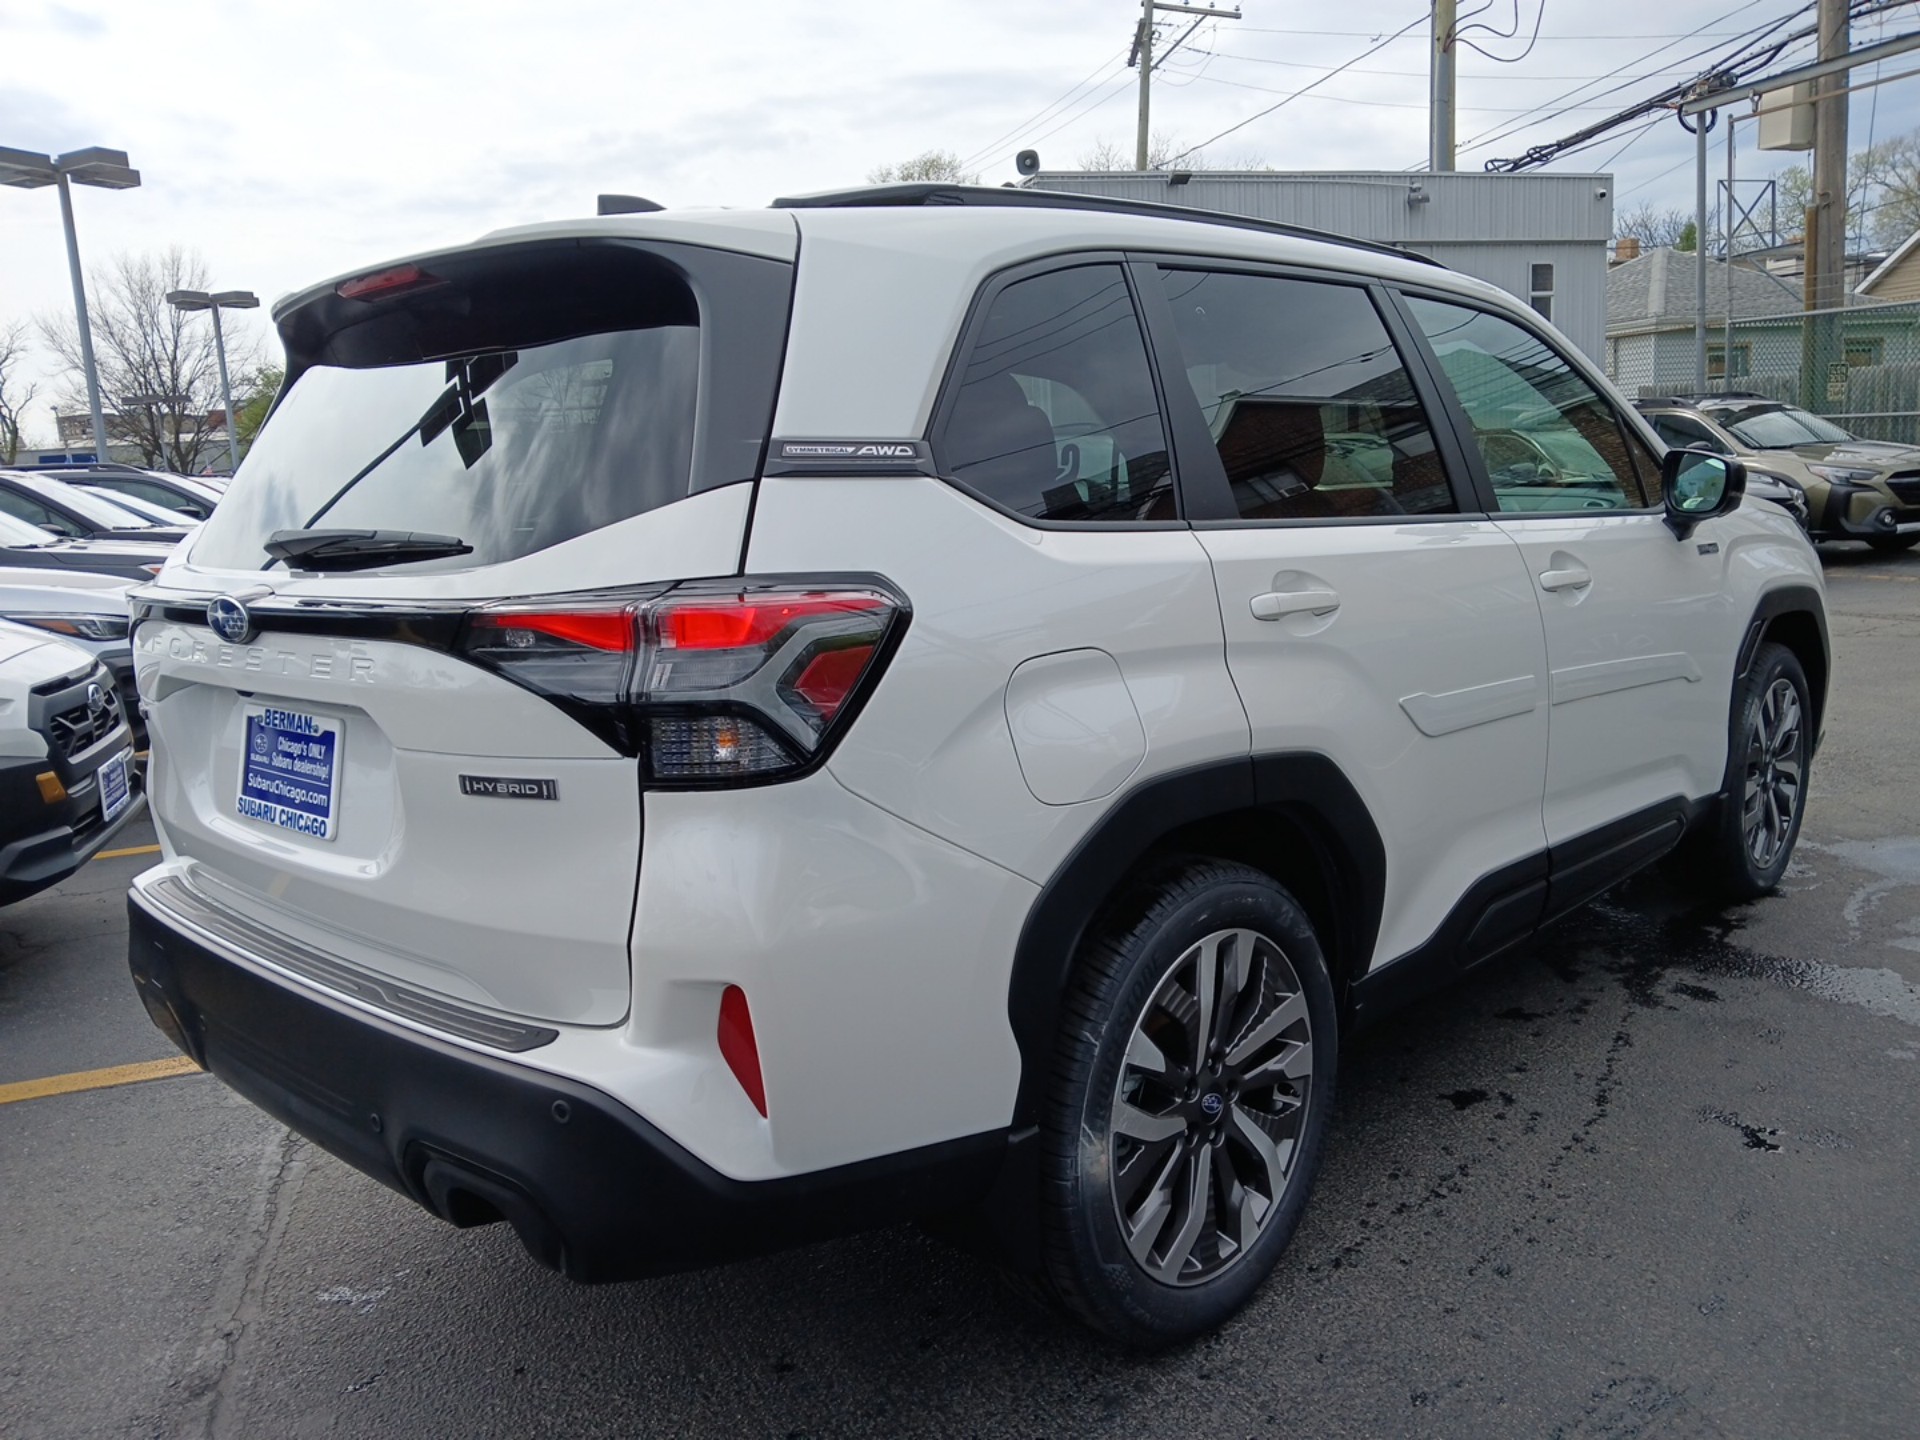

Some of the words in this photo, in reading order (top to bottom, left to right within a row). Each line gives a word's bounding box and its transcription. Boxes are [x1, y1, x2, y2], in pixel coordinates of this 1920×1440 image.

[787, 446, 849, 454] SYMMETRICAL
[856, 446, 913, 455] AWD
[151, 635, 376, 684] FORESTER
[264, 708, 313, 734] BERMAN
[277, 736, 307, 757] Chicago's
[308, 743, 326, 760] ONLY
[271, 752, 293, 770] Subaru
[247, 773, 328, 808] SubaruChicago.com
[472, 781, 539, 794] HYBRID
[237, 797, 277, 823] SUBARU
[278, 809, 328, 838] CHICAGO
